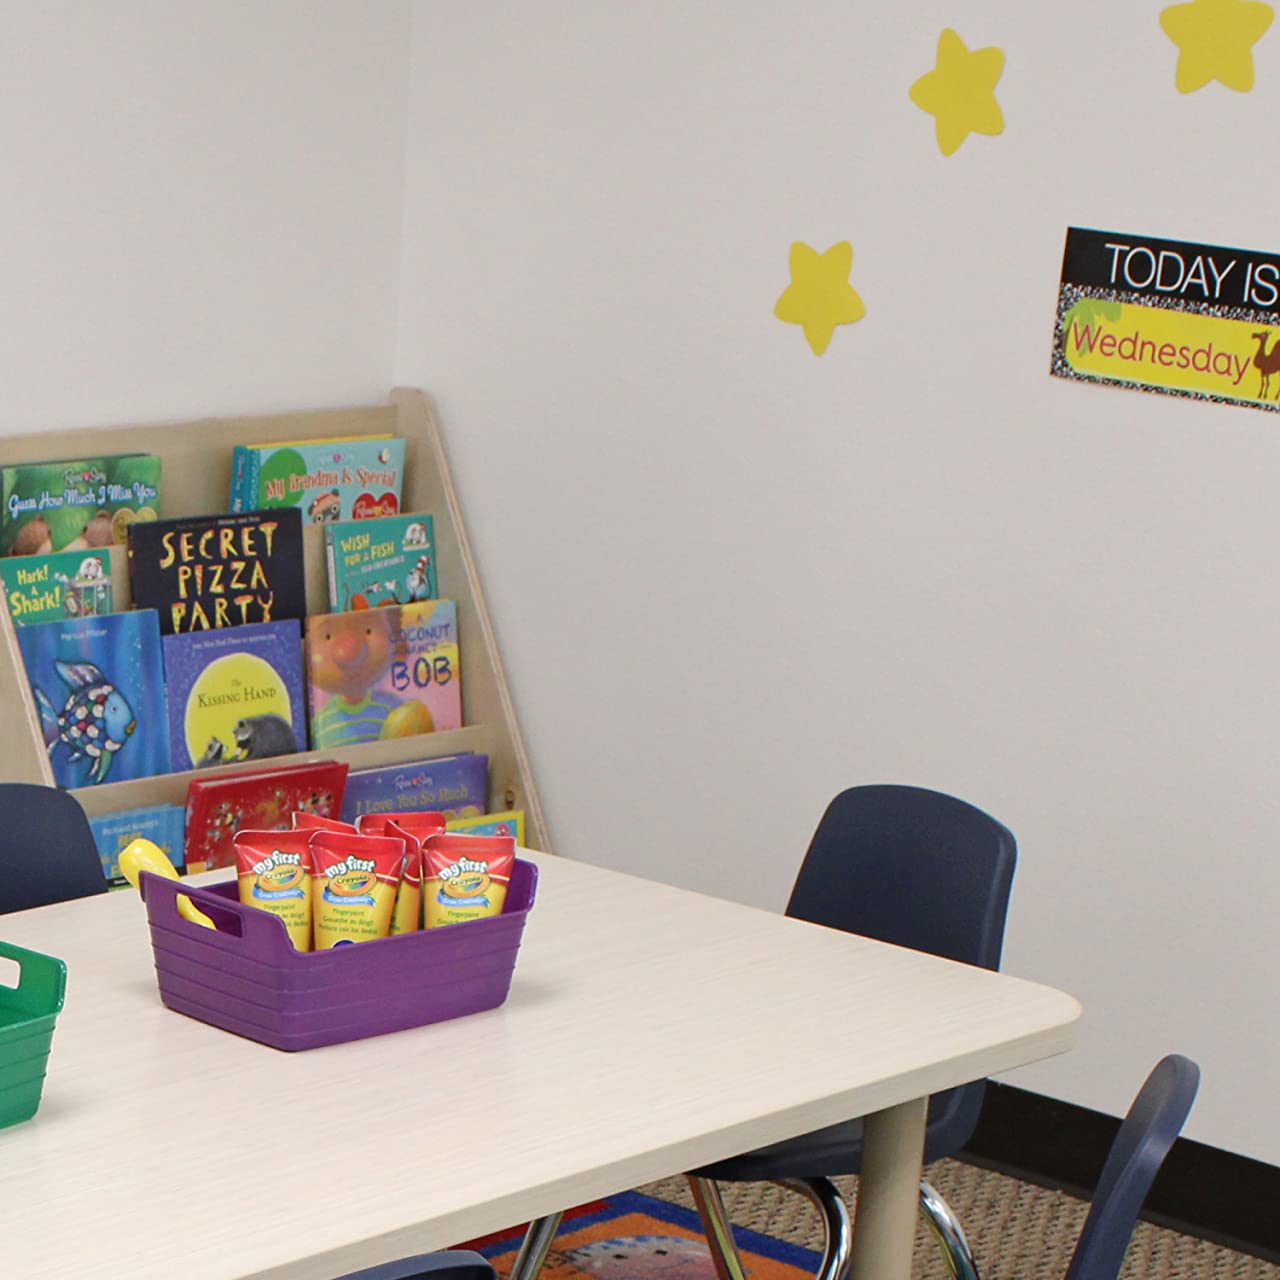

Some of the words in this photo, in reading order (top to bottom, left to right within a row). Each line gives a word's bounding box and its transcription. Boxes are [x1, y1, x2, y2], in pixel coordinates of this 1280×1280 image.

[1104, 242, 1237, 299] TODAY
[1243, 261, 1280, 307] IS
[1072, 321, 1251, 386] Wednesday
[265, 477, 286, 500] My
[288, 467, 338, 491] Grandma
[342, 467, 352, 484] Is
[356, 466, 397, 487] Special
[8, 493, 37, 520] Guess
[38, 491, 64, 511] How
[64, 487, 96, 505] Much
[98, 484, 107, 505] I
[107, 482, 133, 500] Miss
[133, 481, 157, 504] You
[159, 521, 279, 570] SECRET
[340, 532, 371, 553] WISH
[370, 541, 395, 560] FISH
[16, 563, 49, 586] Hark!
[177, 559, 269, 600] PIZZA
[9, 585, 61, 617] Shark!
[170, 590, 275, 635] PARTY
[390, 655, 453, 692] BOB
[364, 798, 393, 814] Love
[252, 857, 275, 874] my
[271, 850, 301, 866] first
[265, 867, 296, 880] Crayola
[324, 861, 347, 878] my
[345, 855, 376, 872] first
[438, 863, 461, 880] my
[458, 856, 489, 873] first
[336, 874, 368, 884] Crayola
[450, 876, 481, 886] Crayola
